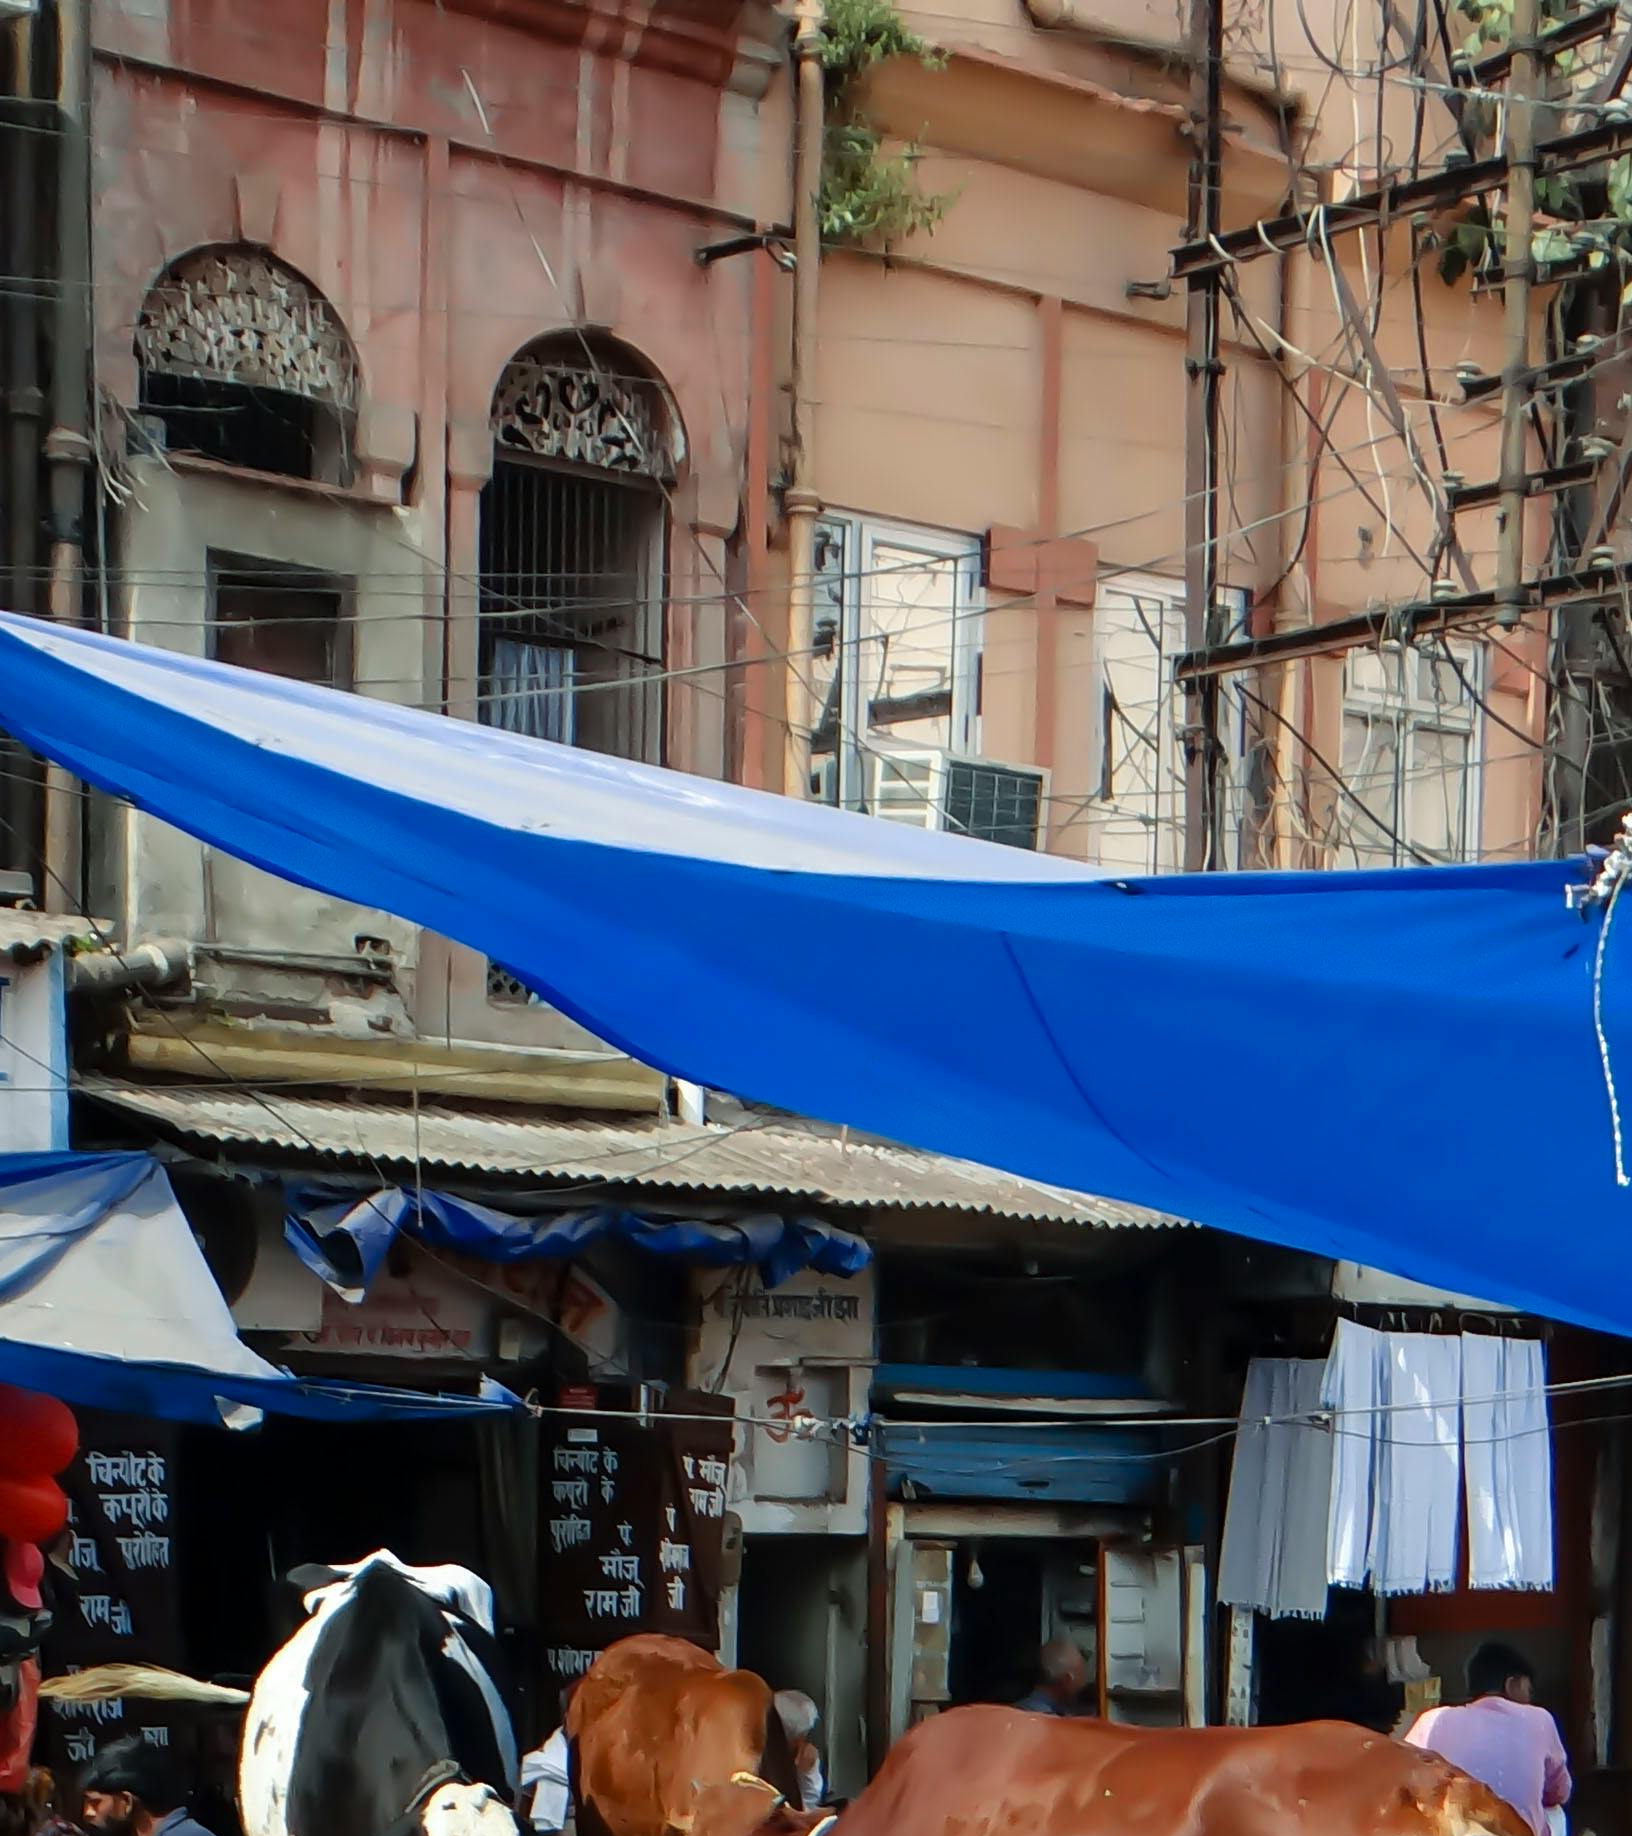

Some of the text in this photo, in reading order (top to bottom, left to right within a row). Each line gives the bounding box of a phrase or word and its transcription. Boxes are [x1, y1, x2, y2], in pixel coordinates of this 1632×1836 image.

[146, 1450, 166, 1488] के
[603, 1446, 619, 1474] के
[150, 1487, 169, 1524] के
[600, 1475, 615, 1506] के
